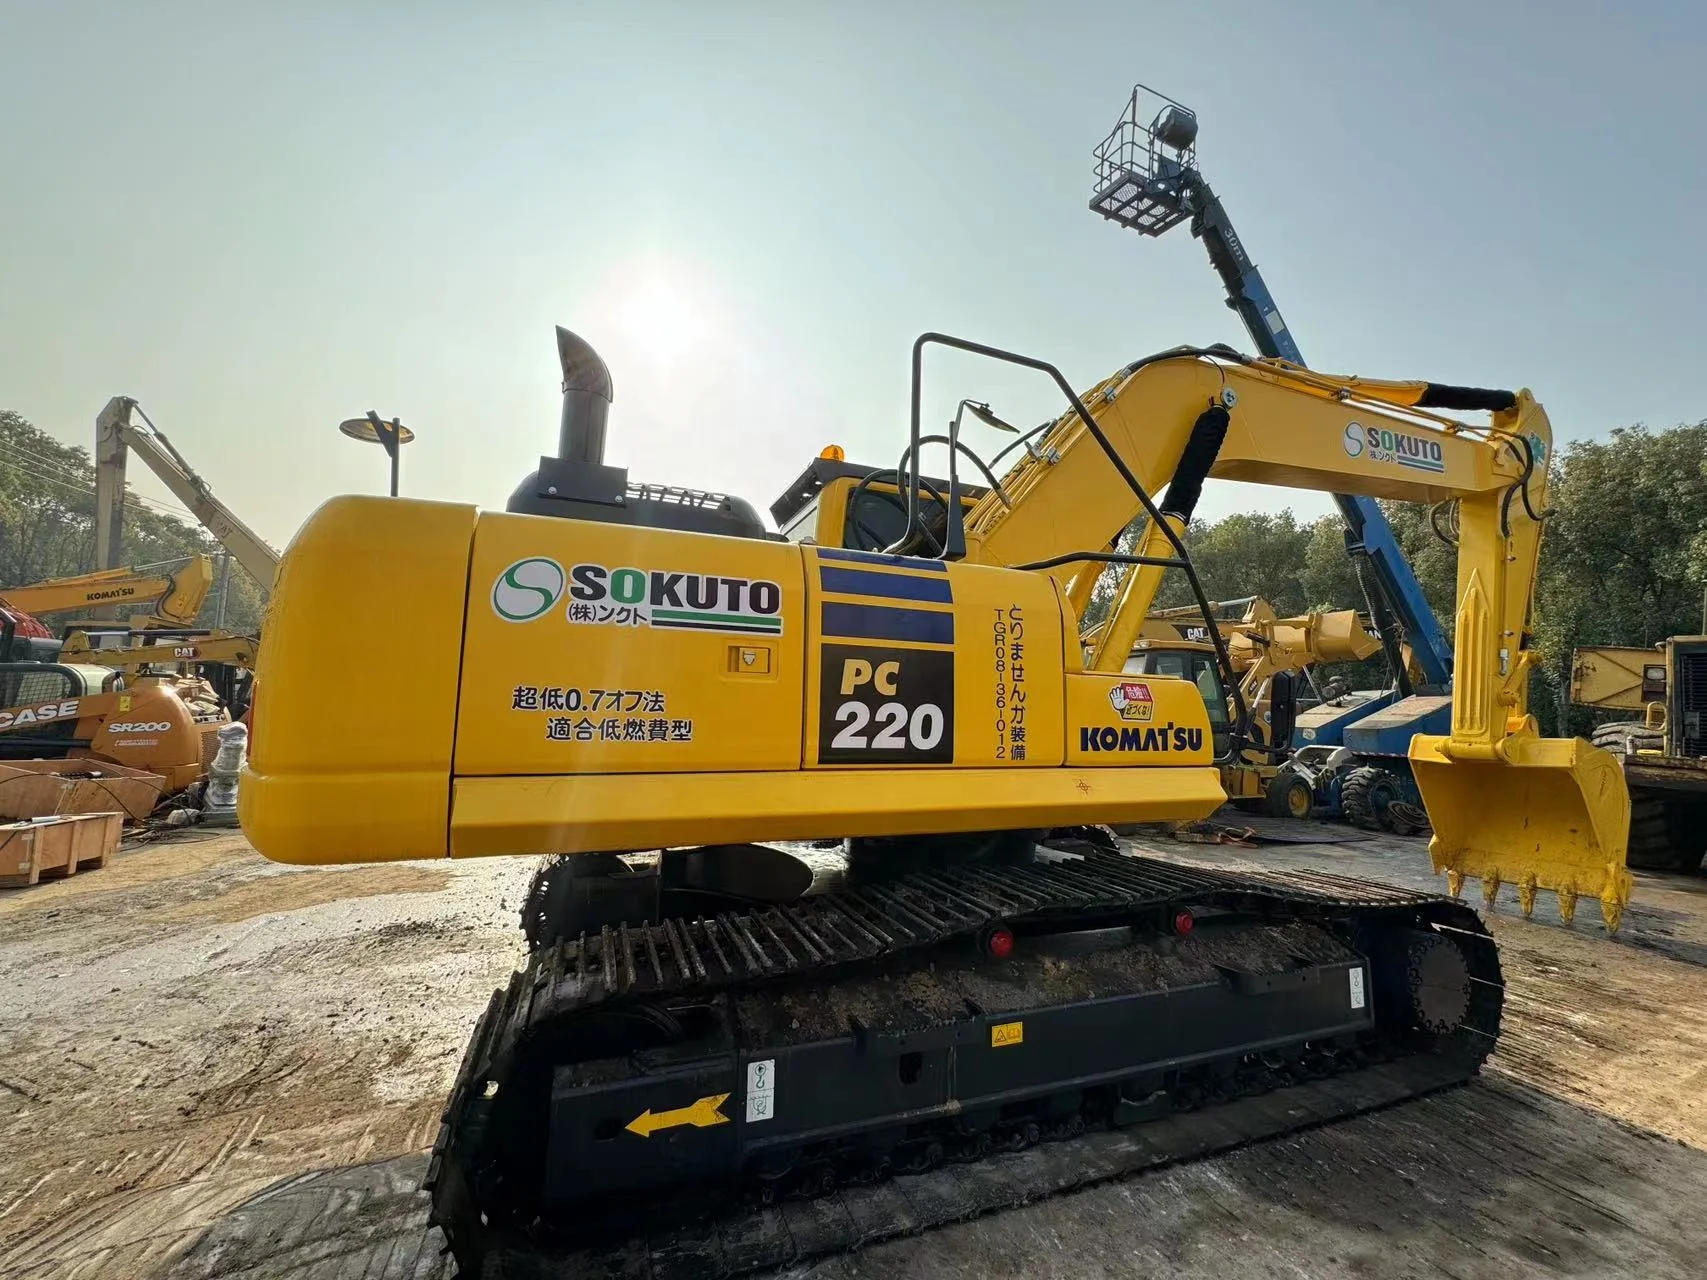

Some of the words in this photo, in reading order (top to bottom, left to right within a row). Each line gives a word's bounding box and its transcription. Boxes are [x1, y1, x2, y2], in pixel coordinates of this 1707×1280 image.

[1224, 228, 1244, 261] 30m
[1366, 427, 1442, 461] SOKUTO
[87, 587, 134, 600] KOMATSU
[570, 565, 780, 614] SOKUTO
[1187, 627, 1204, 639] CAT
[174, 647, 195, 658] CAT
[840, 658, 900, 696] PC
[0, 700, 80, 729] CASE
[108, 721, 172, 733] SR200
[831, 701, 944, 750] 220
[546, 717, 692, 742] 適合低燃費型
[1080, 722, 1203, 751] KOMATSU
